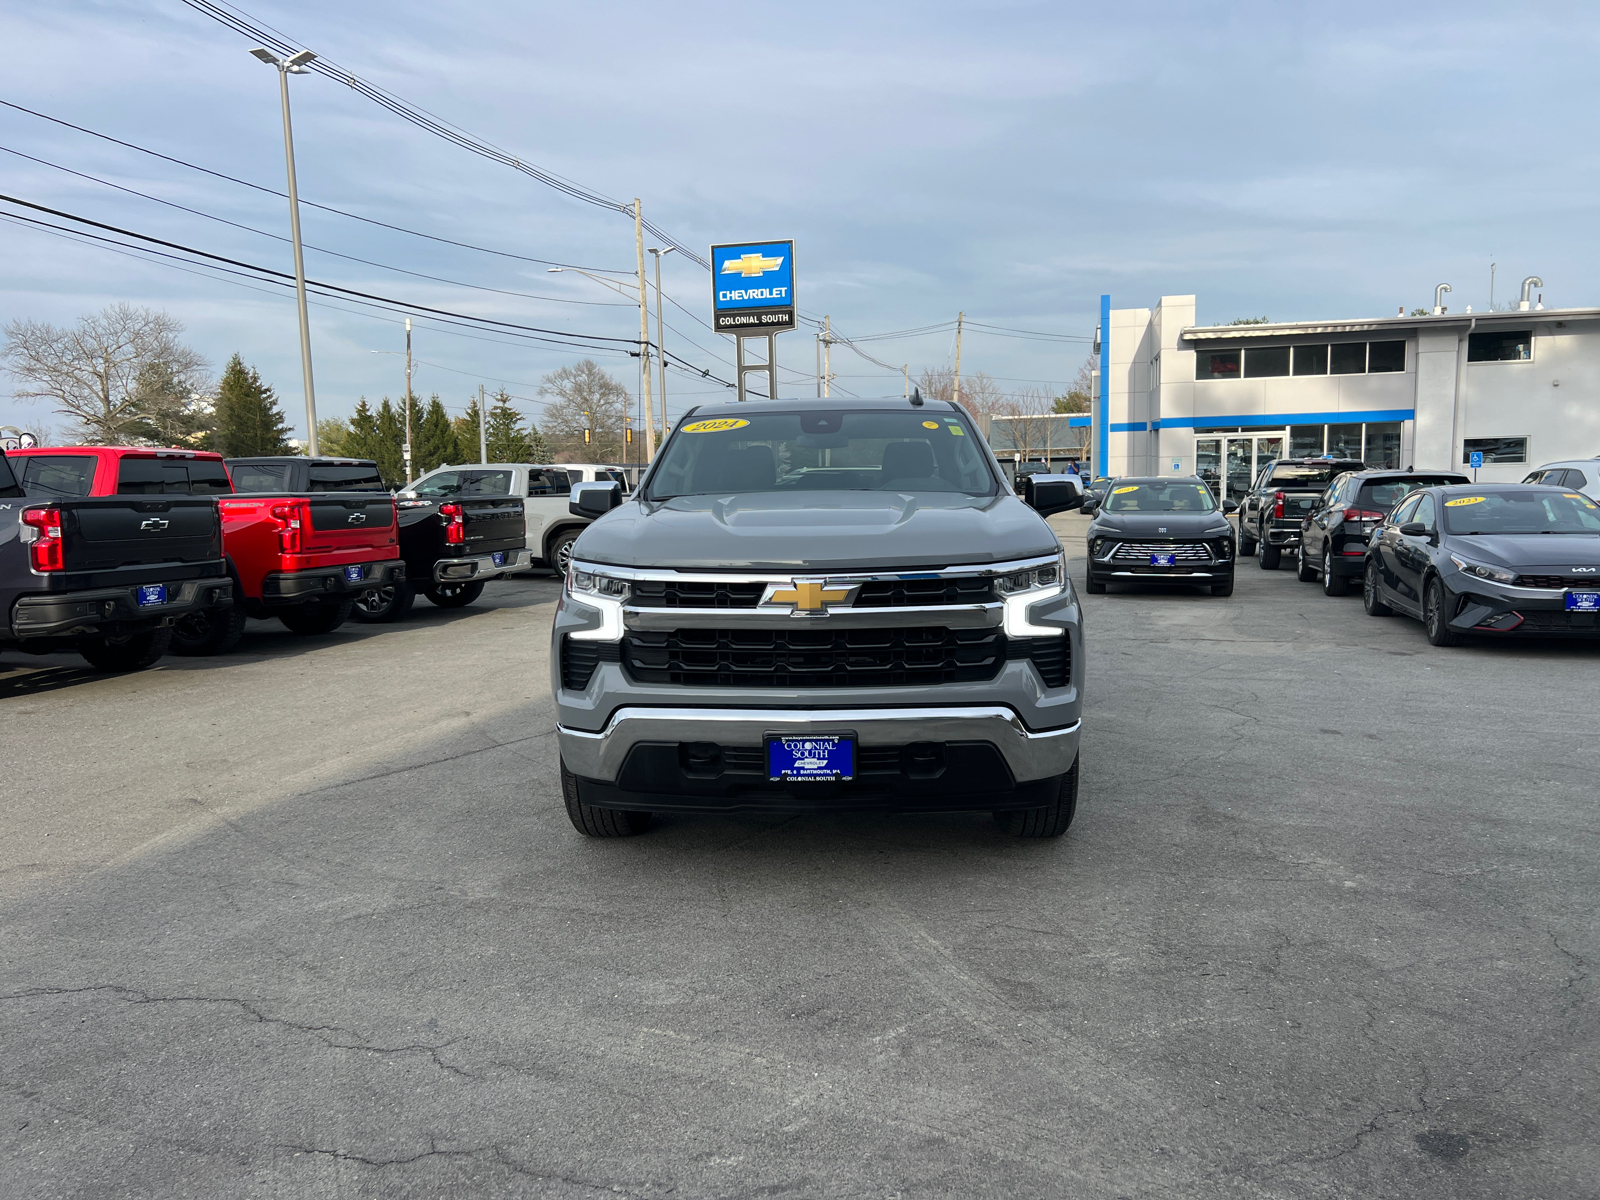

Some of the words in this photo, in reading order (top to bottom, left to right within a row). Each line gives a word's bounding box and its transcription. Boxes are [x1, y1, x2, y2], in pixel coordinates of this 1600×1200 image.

[719, 287, 788, 301] CHEVROLET
[719, 315, 759, 325] COLONIAL
[761, 314, 789, 323] SOUTH
[690, 420, 740, 431] 2024
[1452, 497, 1479, 506] 2023
[784, 741, 836, 750] COLONIAL
[792, 750, 828, 758] SOUTH
